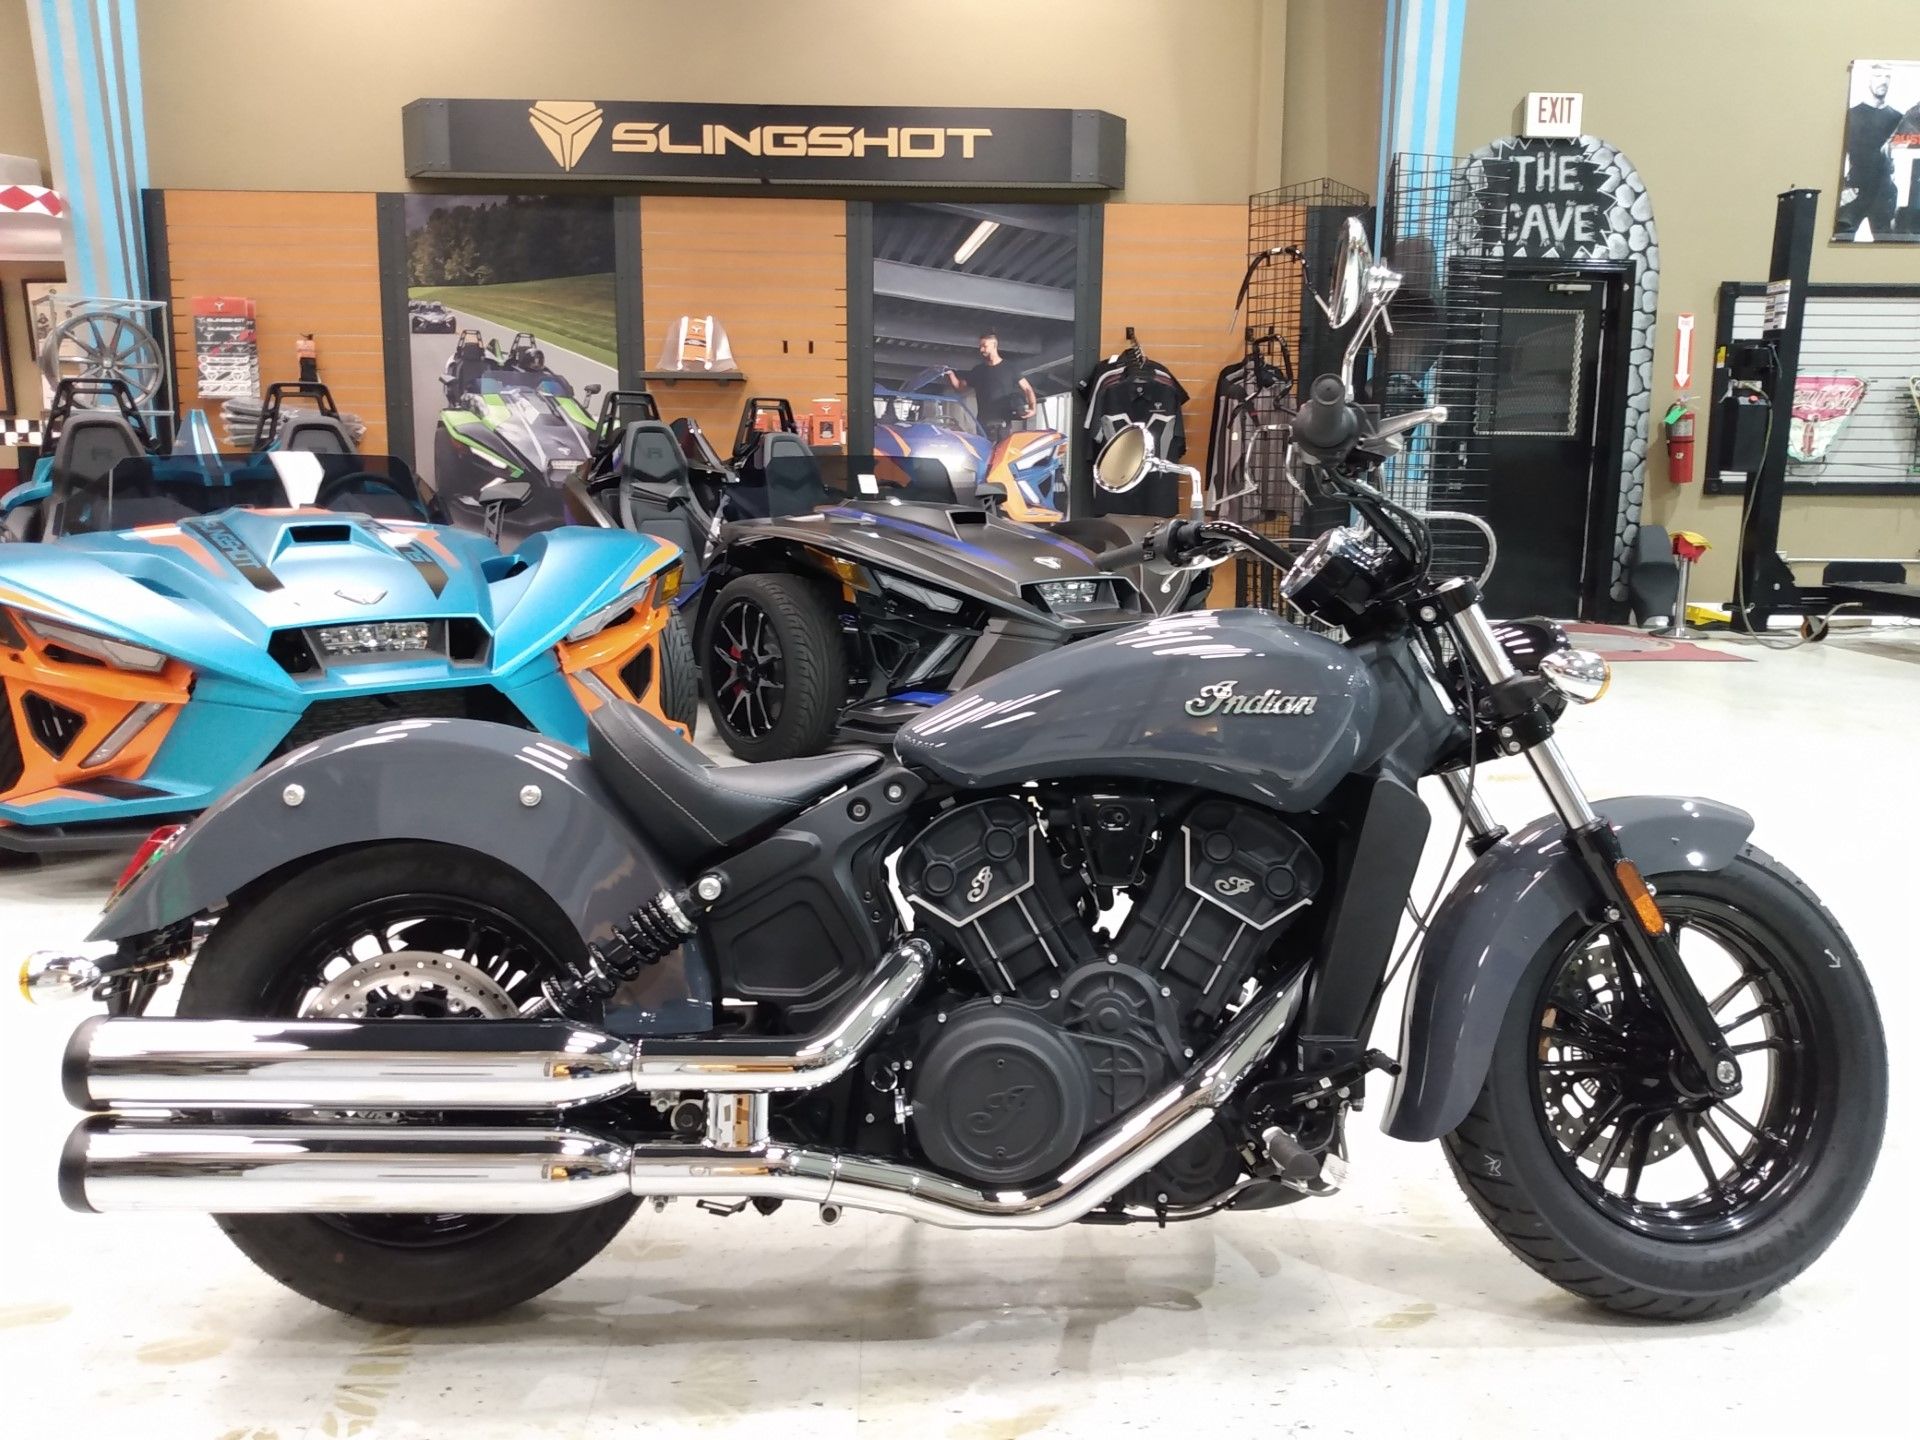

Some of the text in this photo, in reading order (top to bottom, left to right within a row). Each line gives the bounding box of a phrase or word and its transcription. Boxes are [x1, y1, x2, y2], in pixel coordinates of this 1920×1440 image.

[1538, 96, 1575, 124] EXIT
[611, 121, 993, 159] SLINGSHOT
[1509, 151, 1584, 193] THE
[1500, 200, 1599, 250] CAVE
[1185, 680, 1318, 717] Indian
